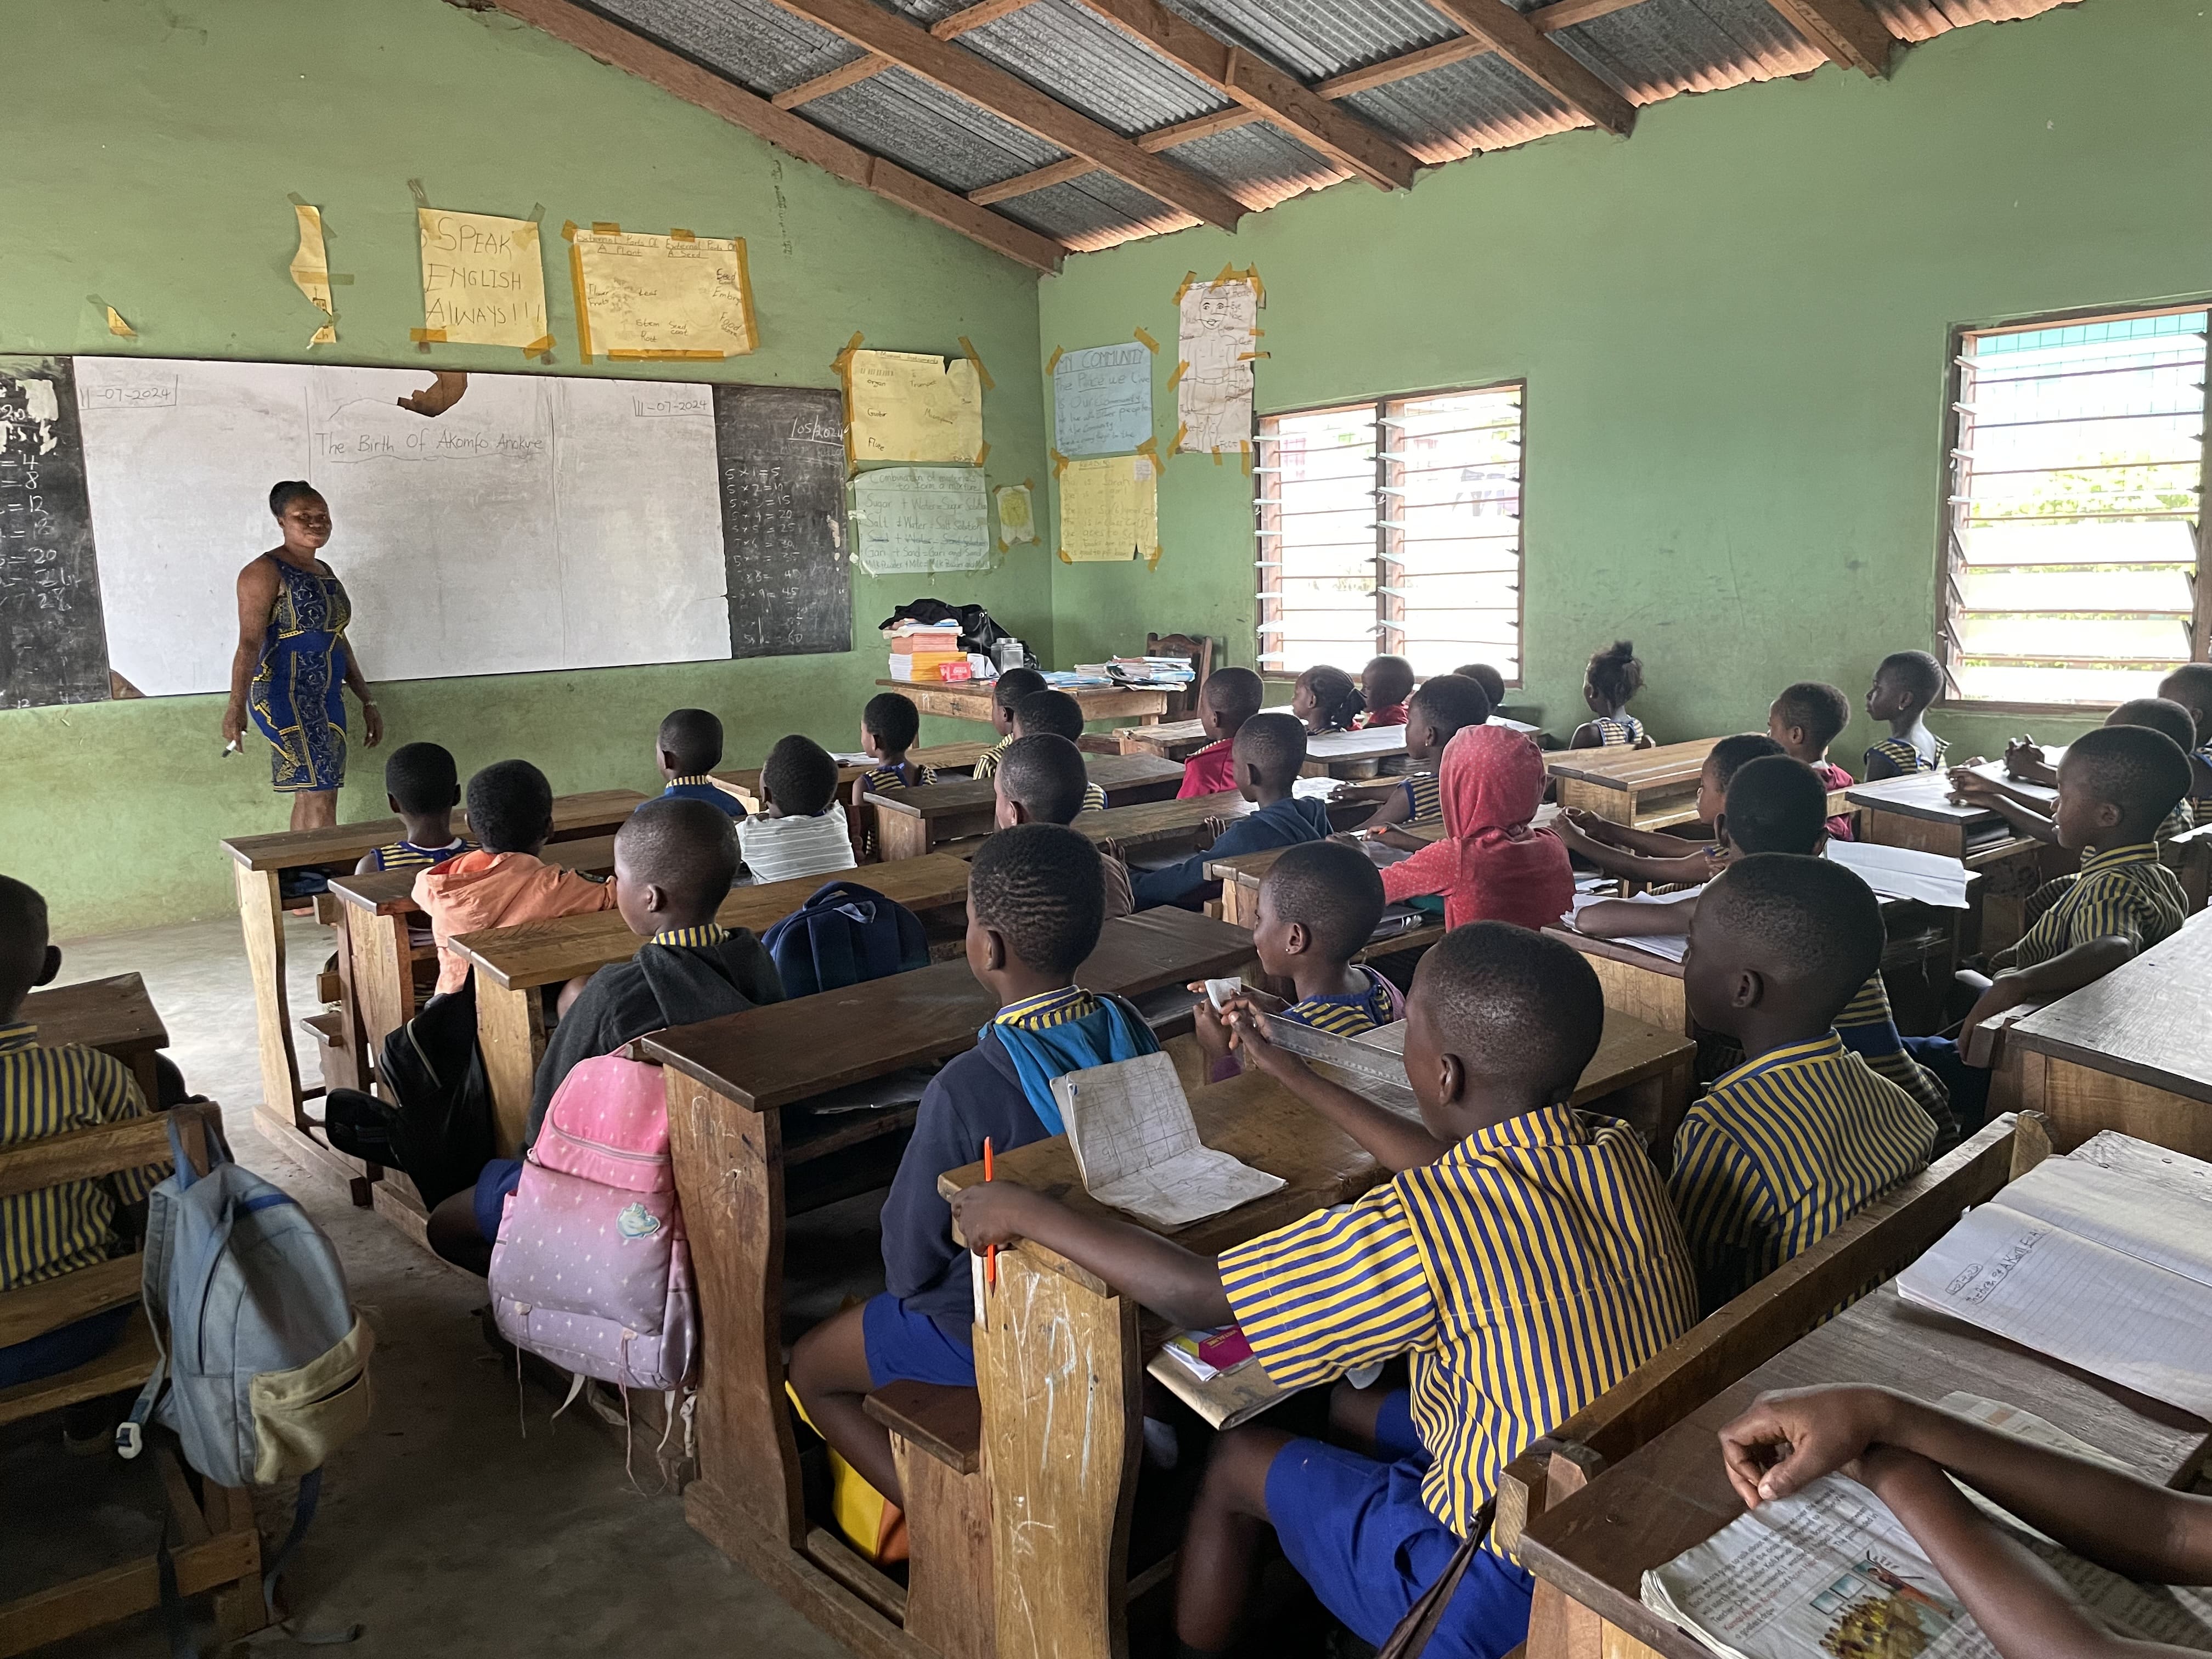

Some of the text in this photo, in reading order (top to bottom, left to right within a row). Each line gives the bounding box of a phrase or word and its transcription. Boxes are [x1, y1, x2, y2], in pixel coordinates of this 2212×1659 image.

[434, 217, 511, 261] SPEAK
[425, 263, 521, 293] ENGLISH
[80, 387, 171, 409] 11-07-2024
[315, 428, 544, 459] The Birth Of Akomfo Anokye
[24, 454, 38, 470] 4
[26, 471, 38, 489] 8
[725, 469, 735, 479] 5
[771, 467, 780, 476] 5
[727, 484, 735, 494] 5
[752, 484, 762, 495] 2
[30, 495, 48, 515] 12
[730, 499, 737, 507] 5
[778, 495, 790, 504] 15
[865, 493, 892, 514] Sugar
[731, 512, 740, 520] 5
[755, 512, 761, 521] 4
[778, 510, 792, 518] 20
[781, 523, 795, 532] 25
[33, 548, 57, 564] 20
[733, 556, 741, 566] 5
[755, 570, 761, 582] 8
[782, 587, 799, 596] 45
